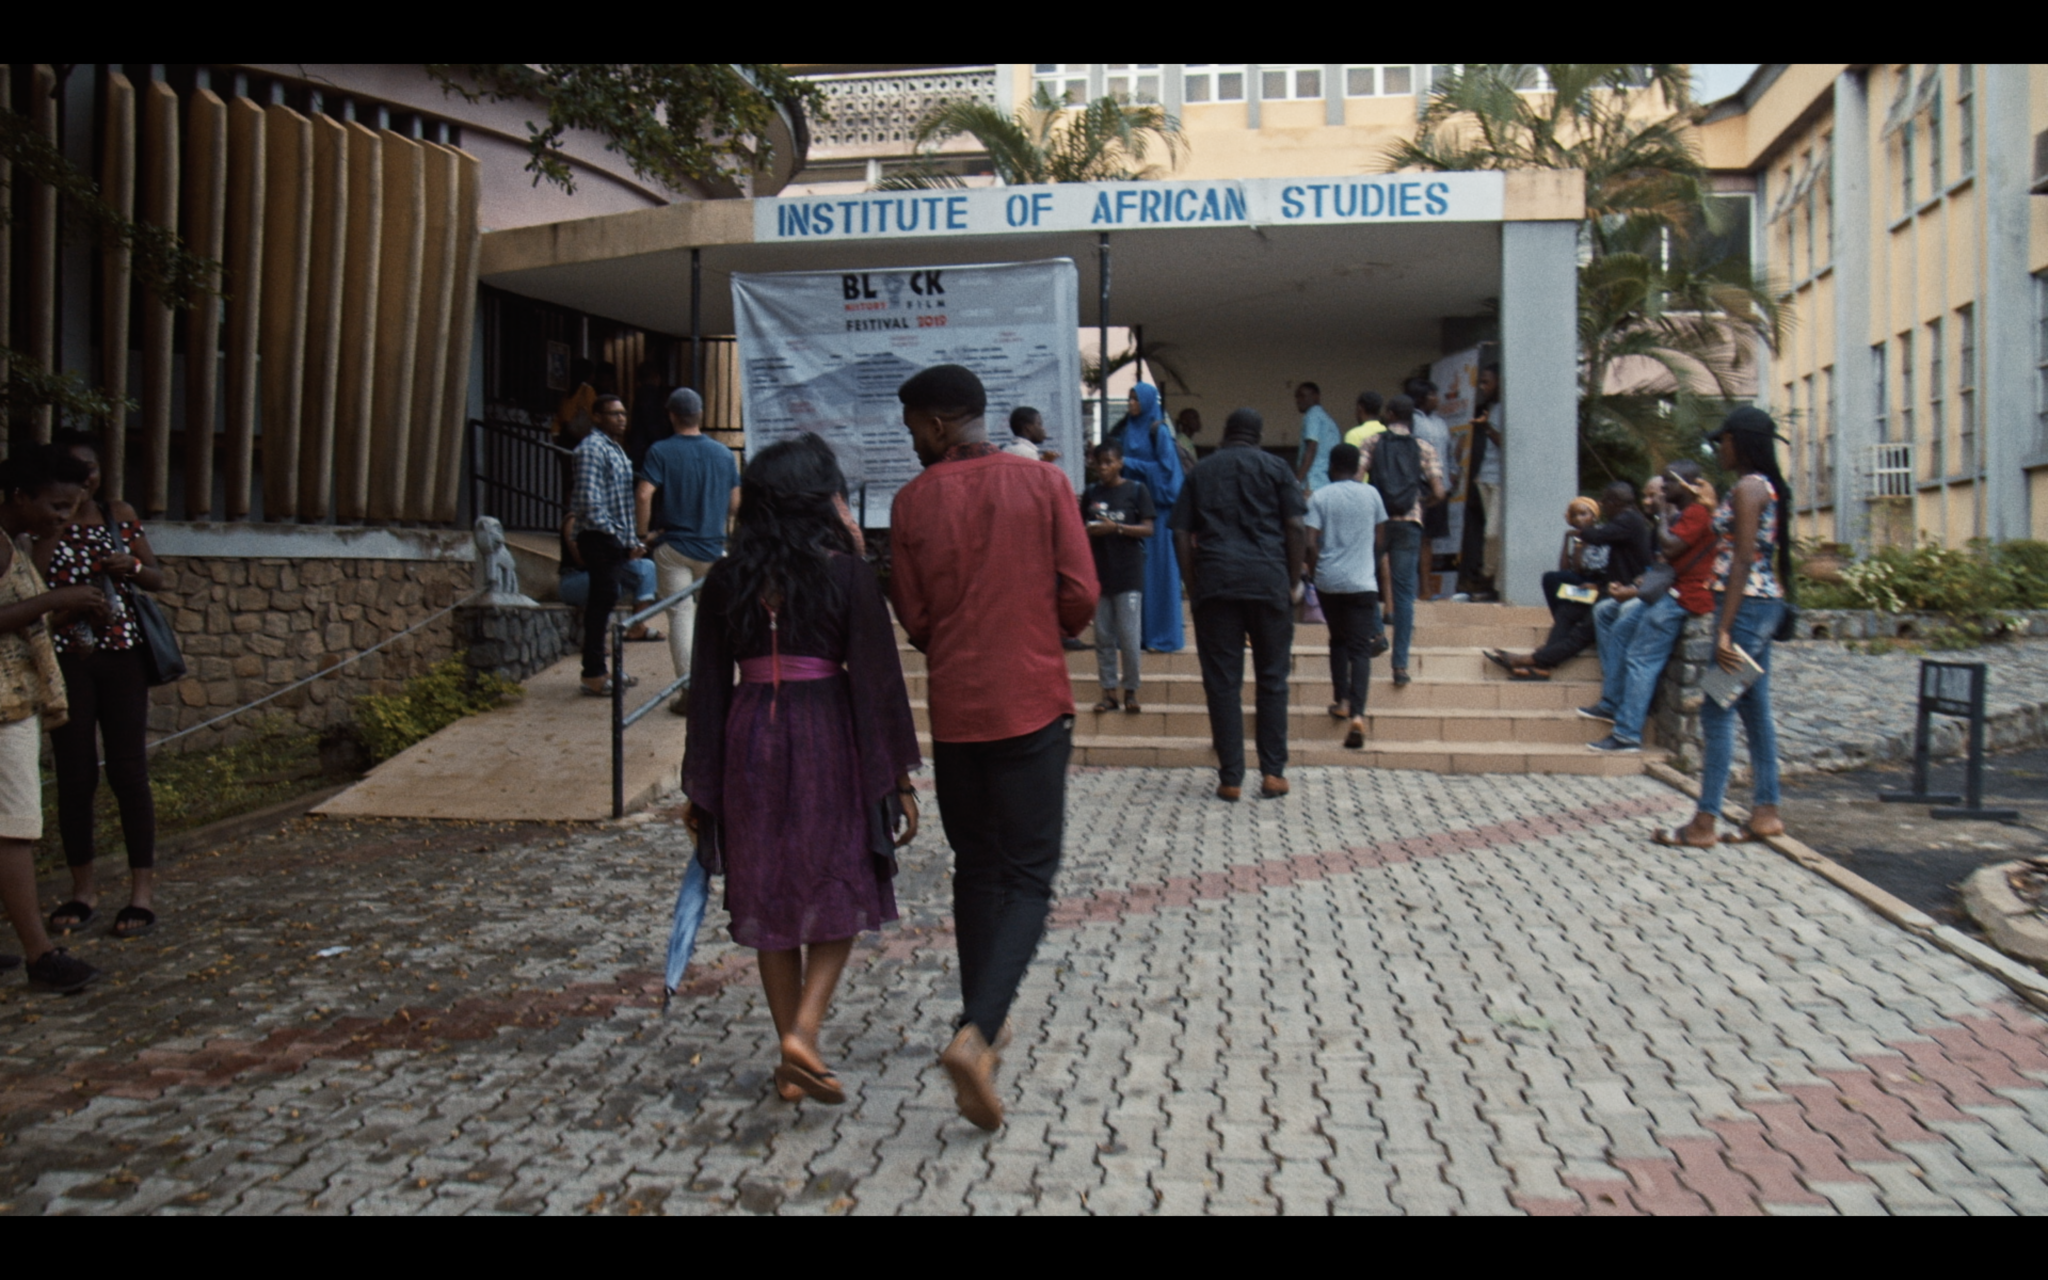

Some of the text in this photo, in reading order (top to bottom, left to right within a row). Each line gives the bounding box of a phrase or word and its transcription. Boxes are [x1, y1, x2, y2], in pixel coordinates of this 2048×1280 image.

[778, 182, 1450, 236] INSTITUTE OF AFRICAN STUDIES
[843, 270, 945, 299] BLCK
[907, 300, 945, 309] FILM
[845, 315, 947, 332] FESTIVAL 2019
